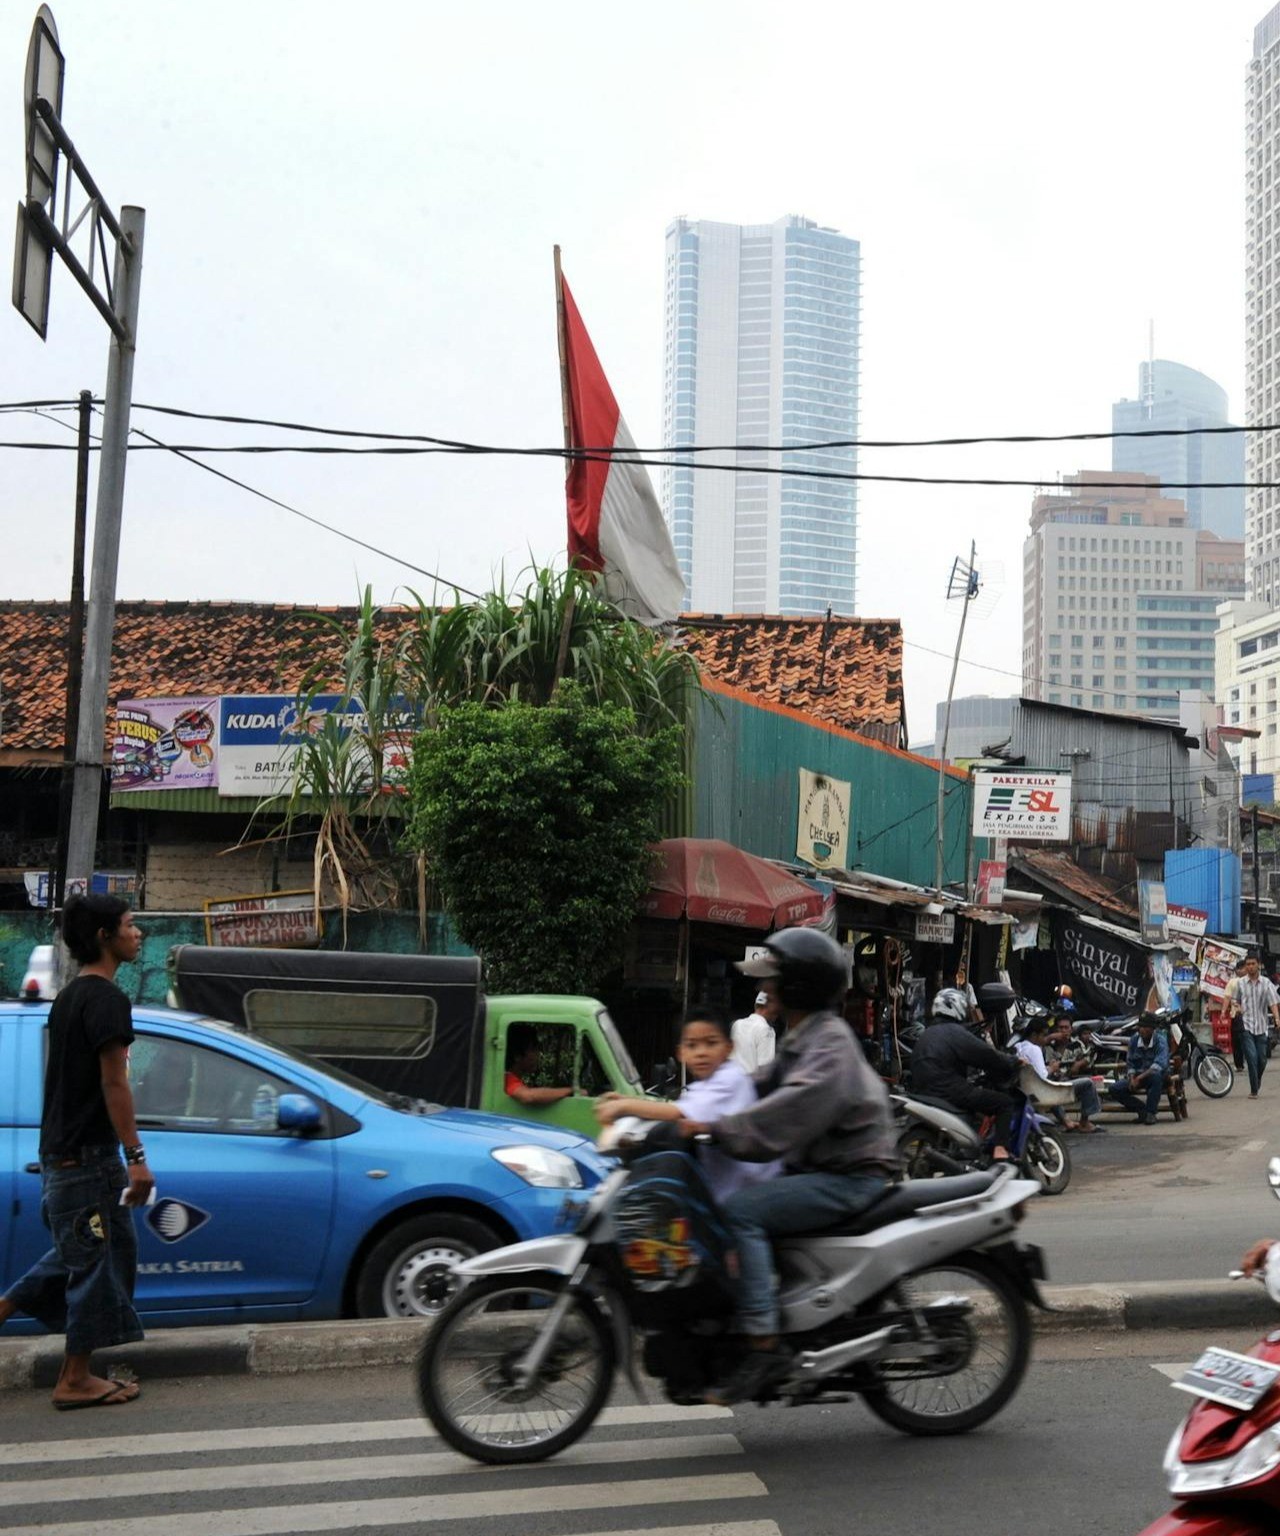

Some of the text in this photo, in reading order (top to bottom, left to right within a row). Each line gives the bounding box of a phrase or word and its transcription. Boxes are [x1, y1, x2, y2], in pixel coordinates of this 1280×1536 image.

[226, 714, 276, 729] KUDA
[993, 777, 1056, 786] PAKET KILAT
[983, 811, 1057, 823] Express
[810, 822, 840, 847] CHELSEA
[219, 927, 307, 947] KAMBING
[1063, 929, 1130, 976] Sinyal
[136, 1263, 173, 1274] AKA
